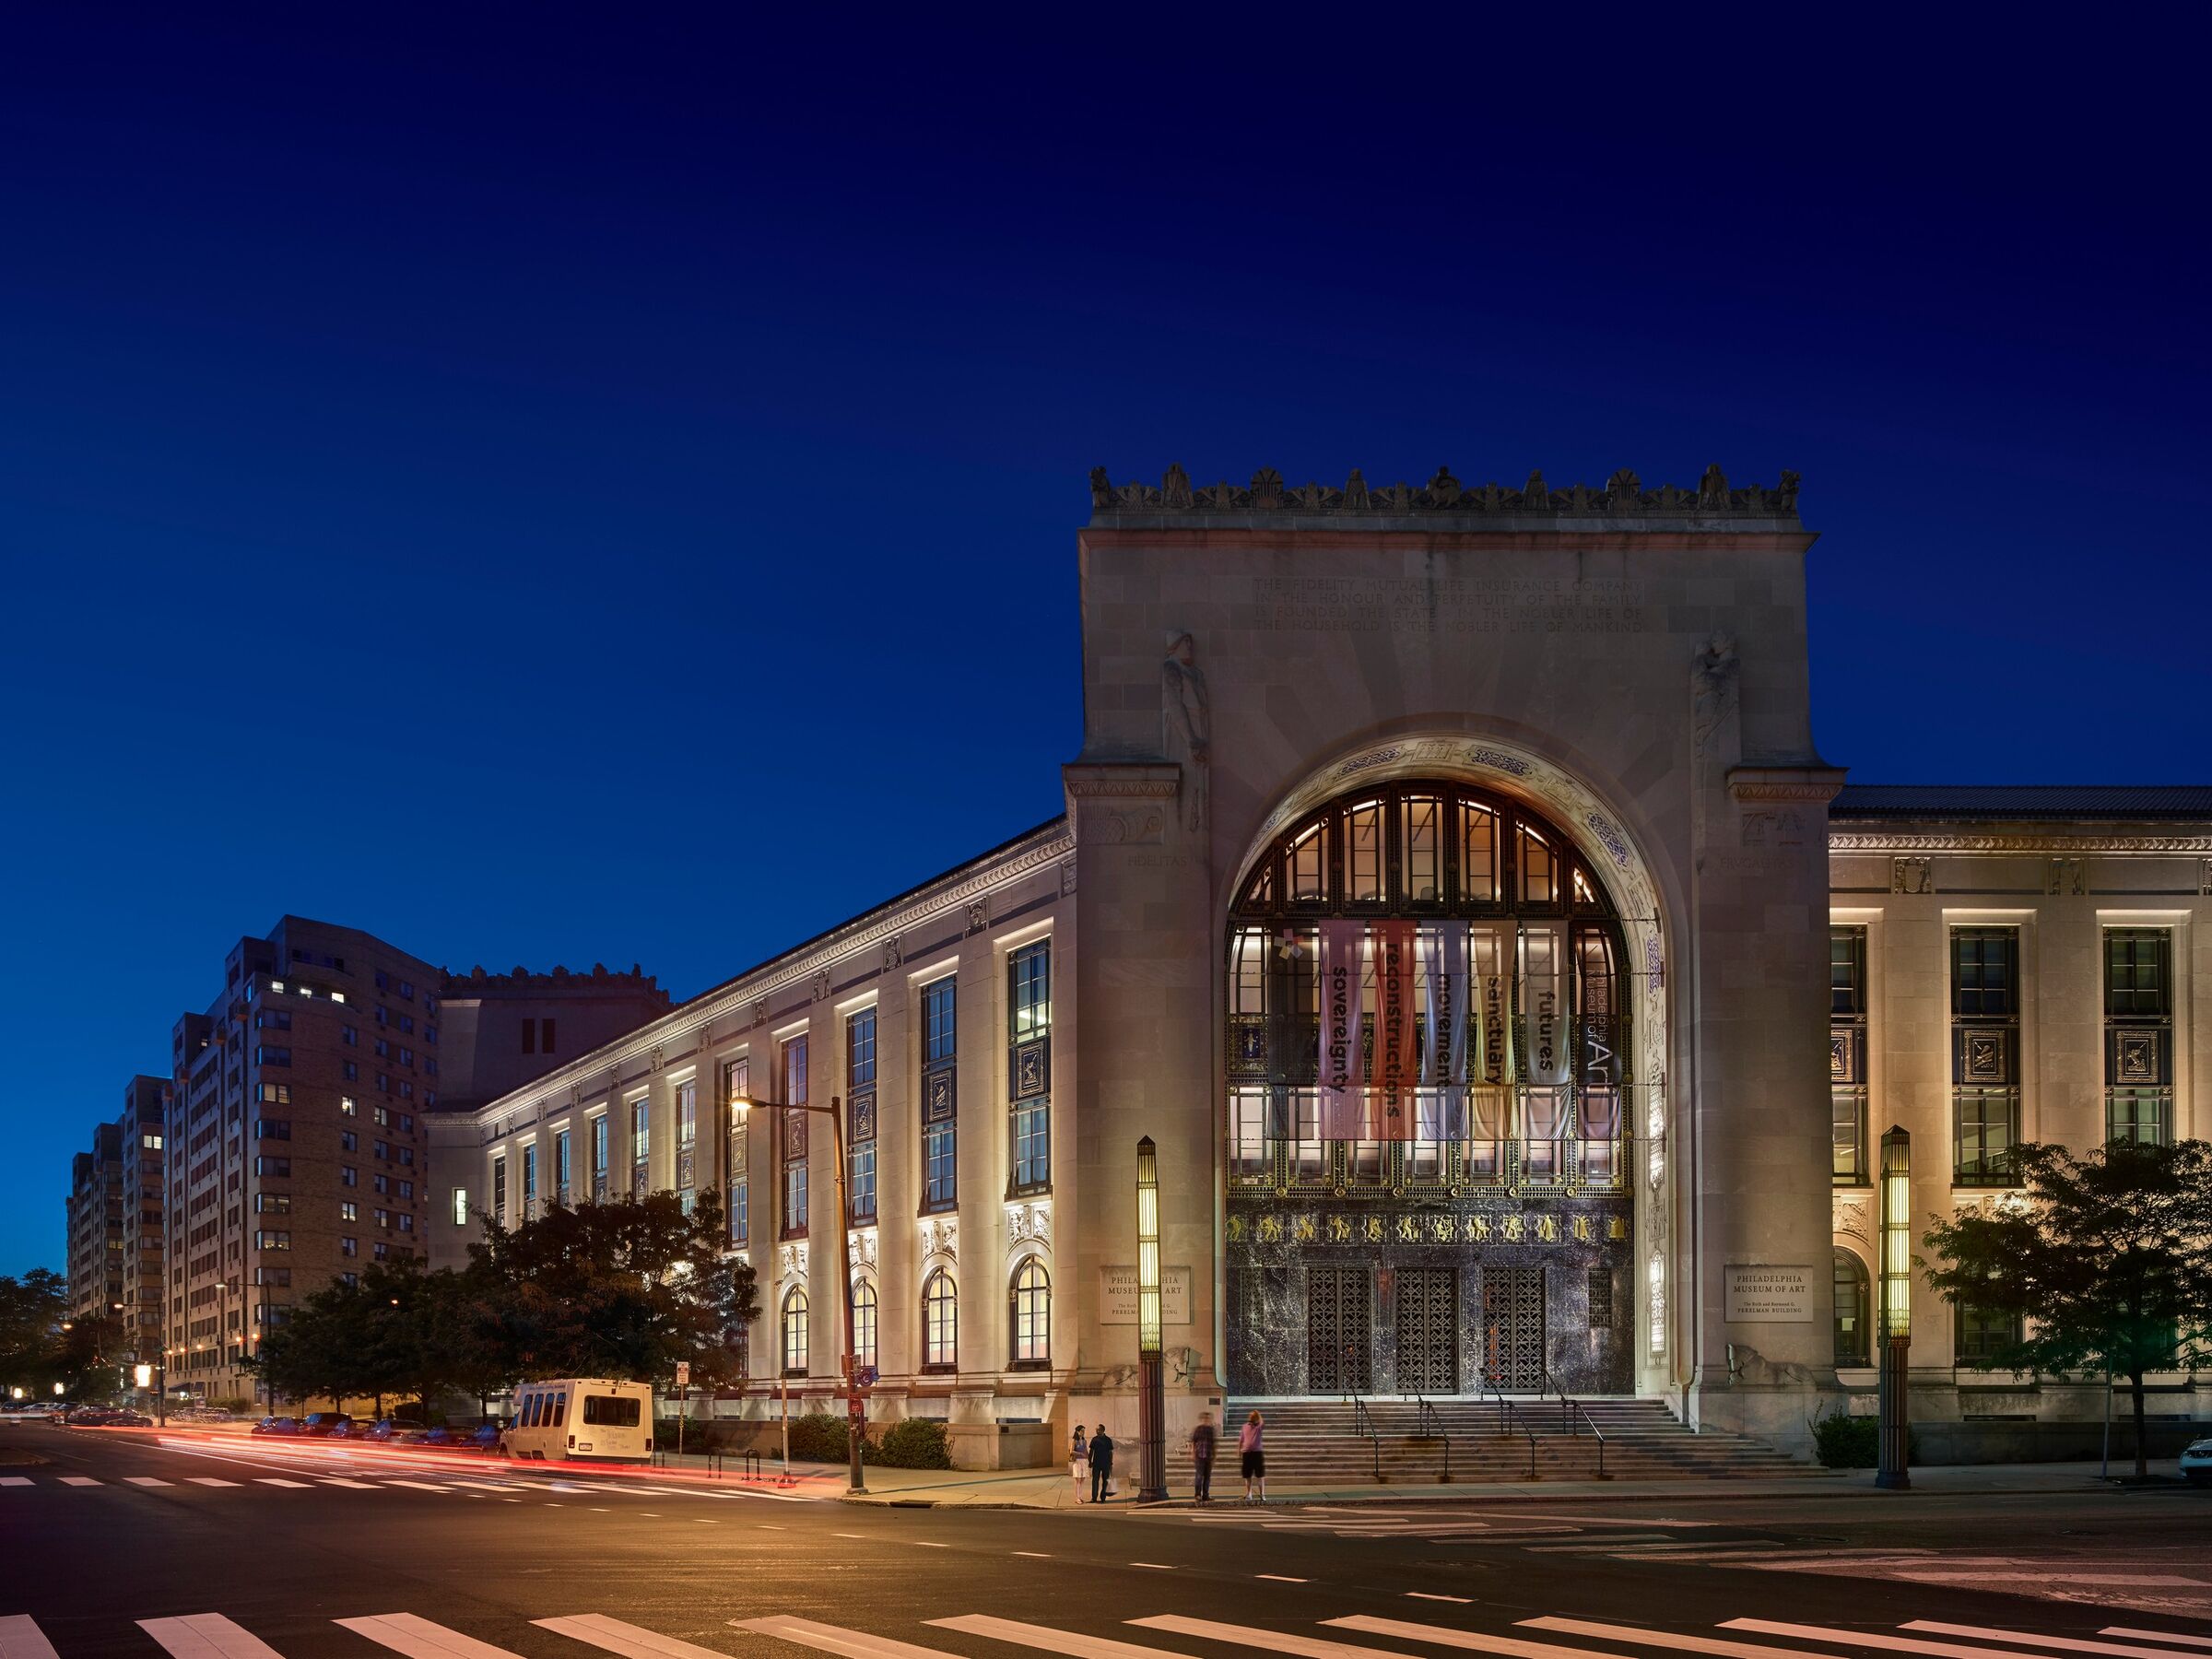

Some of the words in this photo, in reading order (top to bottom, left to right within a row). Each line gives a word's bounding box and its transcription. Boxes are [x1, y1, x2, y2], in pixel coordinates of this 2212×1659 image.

[1253, 579, 1282, 591] THE
[1293, 579, 1355, 591] FIDELITY
[1365, 580, 1428, 592] MUTUAL
[1476, 580, 1560, 592] INSURANCE
[1571, 581, 1642, 593] COMPANY
[1254, 593, 1271, 604] IN
[1282, 593, 1308, 604] THE
[1319, 594, 1384, 605] HONOUR
[1394, 594, 1425, 605] AND
[1525, 594, 1545, 605] OF
[1555, 594, 1582, 606] THE
[1592, 594, 1641, 606] FAMILY
[1253, 620, 1282, 631] THE
[1292, 620, 1380, 631] HOUSEHOLD
[1408, 621, 1436, 632] THE
[1509, 621, 1535, 632] LIFE
[1546, 622, 1563, 633] OF
[1571, 622, 1644, 633] MANKIND
[1277, 606, 1347, 618] FOUNDED
[1358, 607, 1385, 618] THE
[1394, 607, 1437, 618] STATE
[1482, 607, 1510, 618] THE
[1519, 608, 1574, 619] NOBLER
[1585, 608, 1612, 619] LIFE
[1623, 608, 1643, 619] OF
[1585, 970, 1595, 1024] Museum
[1328, 966, 1352, 1094] sovereignty
[1385, 943, 1405, 1118] reconstructions
[1435, 973, 1453, 1088] movement
[1484, 977, 1504, 1086] sanctuary
[1537, 991, 1556, 1071] futures
[1587, 1025, 1599, 1039] of
[1587, 1041, 1614, 1089] Art
